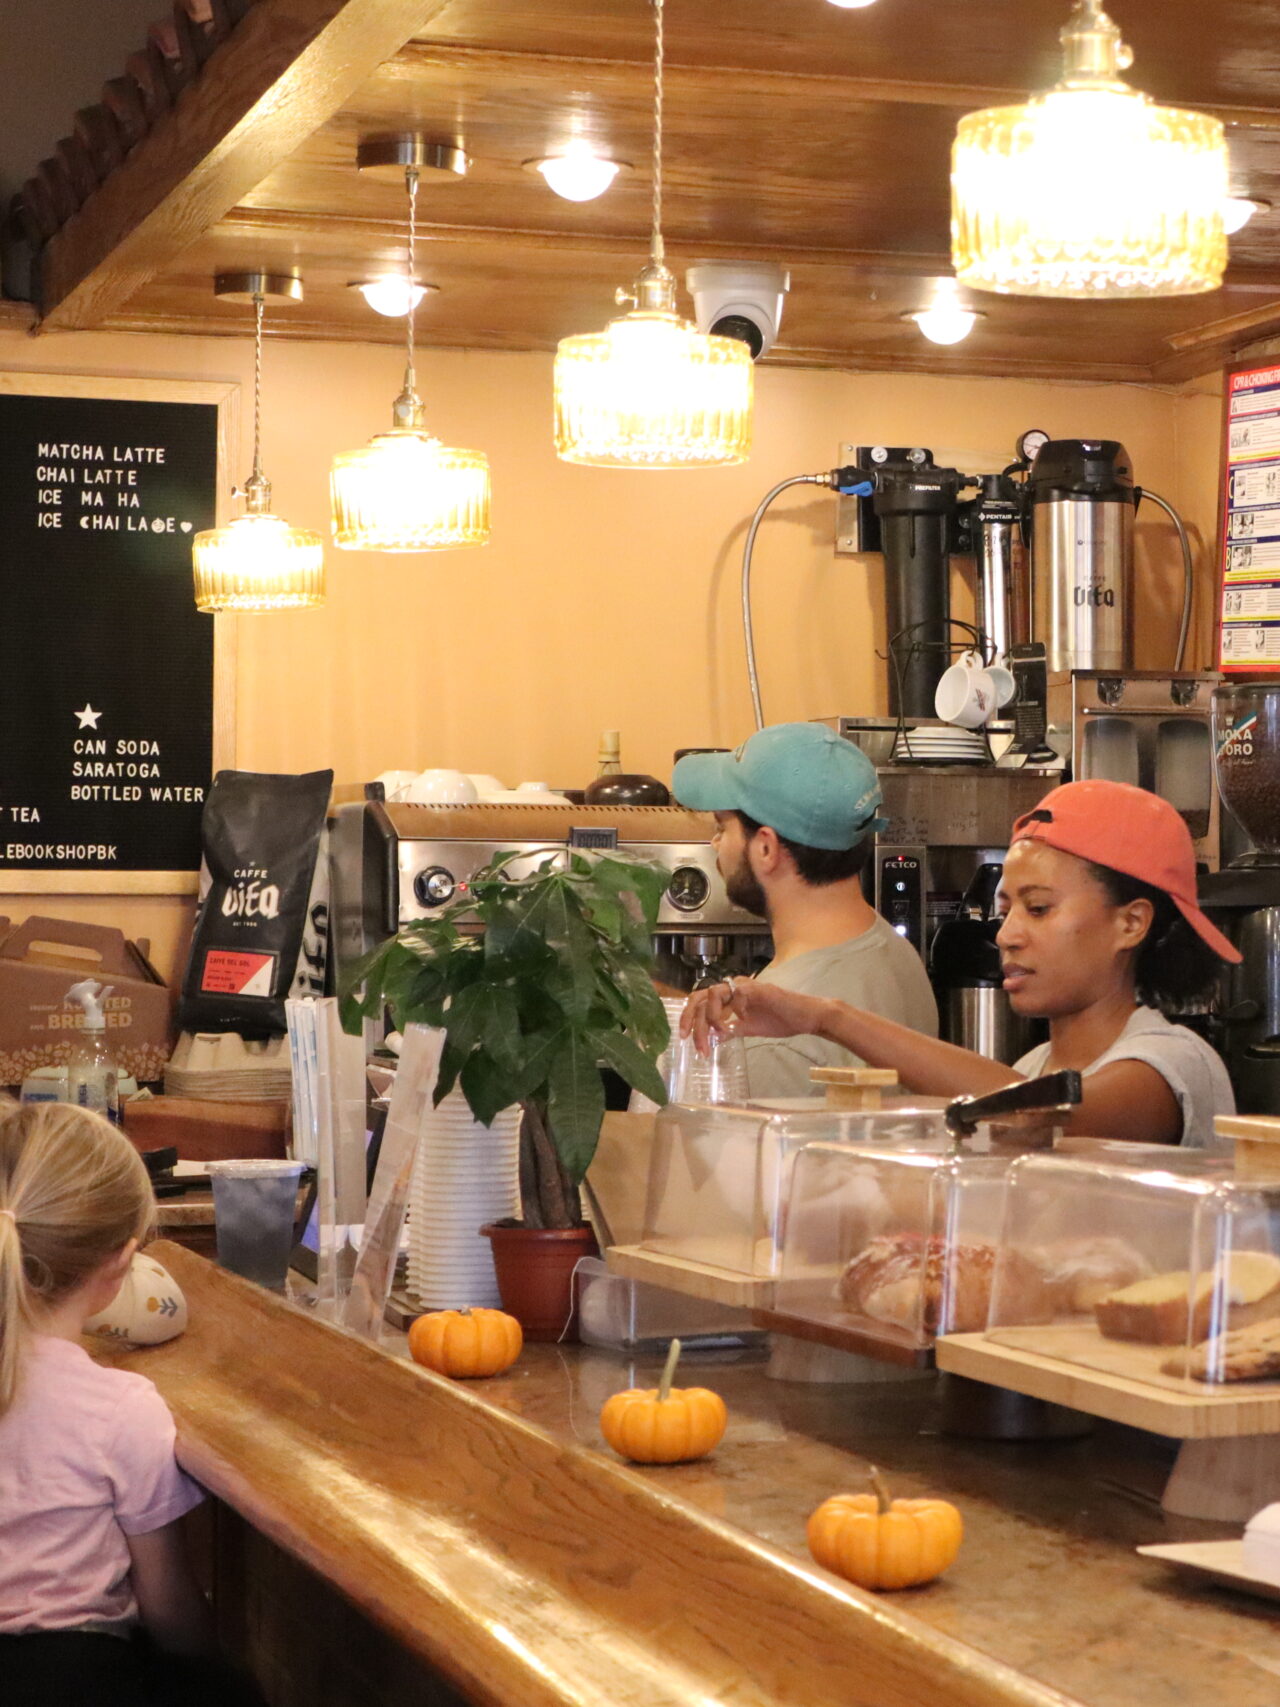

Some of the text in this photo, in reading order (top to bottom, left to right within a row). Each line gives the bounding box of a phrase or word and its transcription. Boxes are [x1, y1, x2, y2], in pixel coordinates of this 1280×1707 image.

[38, 443, 166, 464] MATCHA LATTE
[36, 466, 137, 486] CHAI LATTE
[38, 489, 140, 508] ICE MA HA
[38, 512, 62, 529] ICE
[73, 739, 160, 756] CAN SODA
[72, 762, 160, 778] SARATOGA
[71, 785, 204, 802] BOTTLED WATER
[11, 807, 40, 823] TEA
[233, 869, 268, 879] CAFFE
[47, 1012, 133, 1030] BREED
